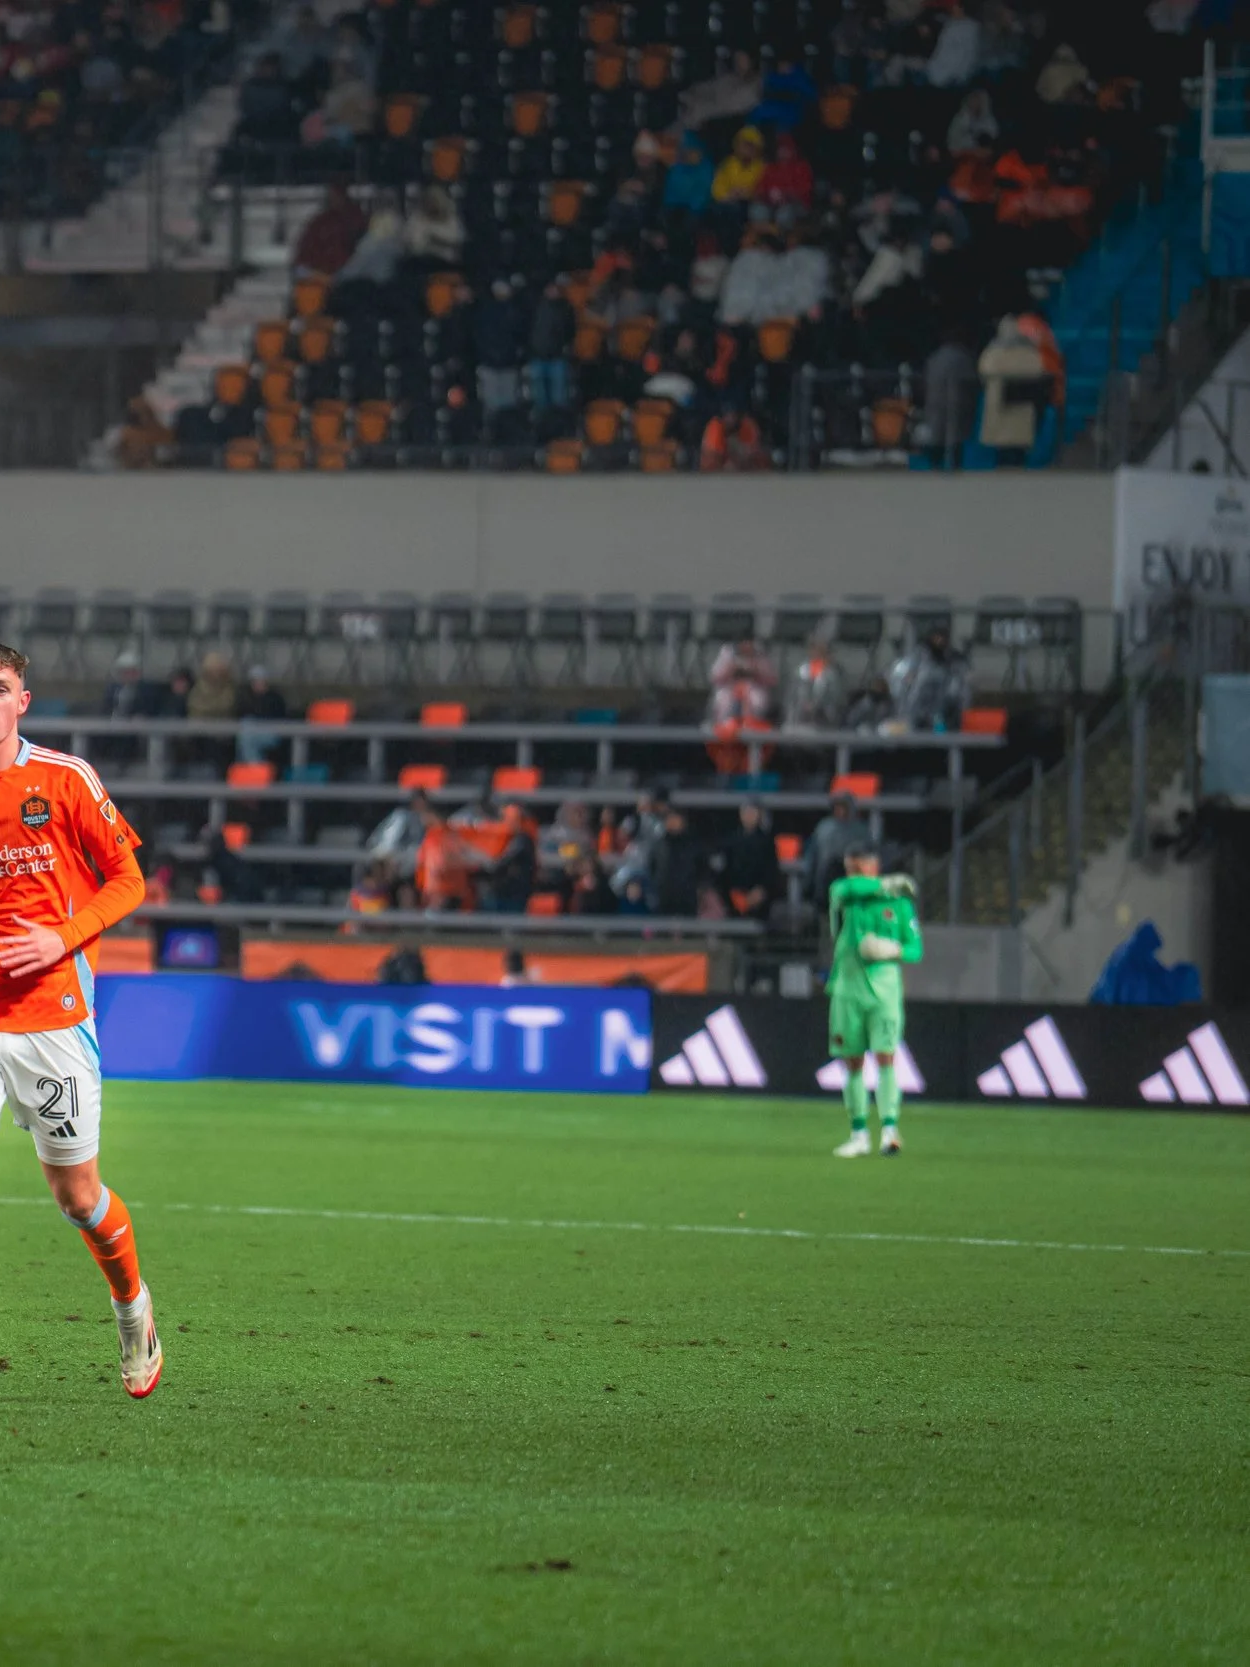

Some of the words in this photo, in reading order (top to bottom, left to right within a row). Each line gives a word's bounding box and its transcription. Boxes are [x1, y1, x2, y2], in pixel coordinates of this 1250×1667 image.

[5, 857, 58, 877] Center
[295, 1002, 565, 1075] VISIT
[36, 1075, 80, 1120] 21
